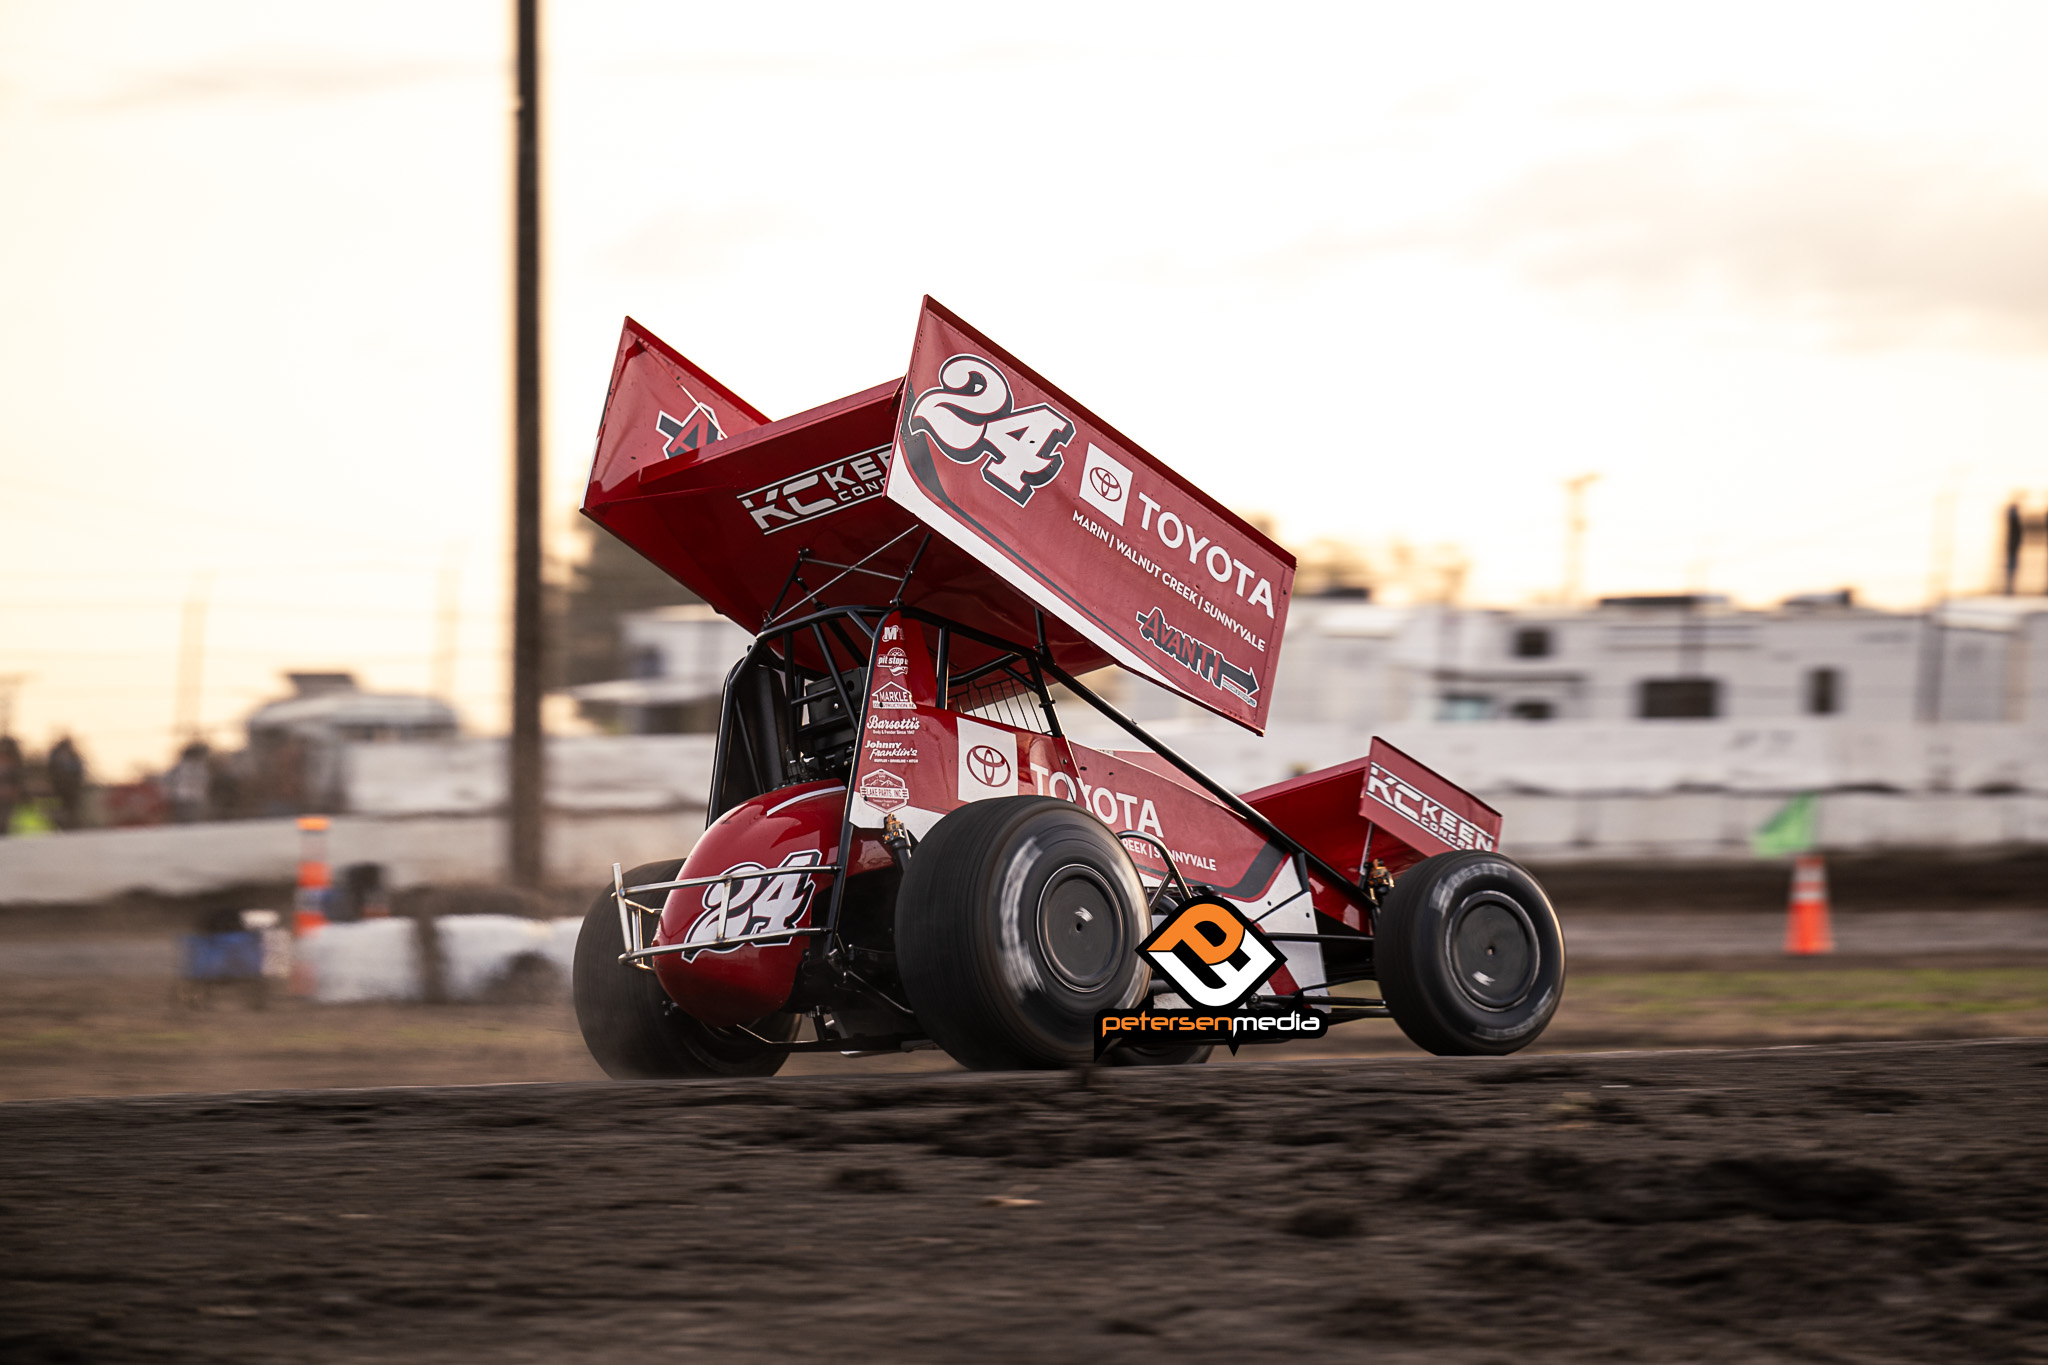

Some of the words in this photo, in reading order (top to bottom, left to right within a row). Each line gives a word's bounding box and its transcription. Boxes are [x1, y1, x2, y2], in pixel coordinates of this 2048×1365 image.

[908, 353, 1076, 508] 24
[1138, 491, 1275, 620] TOYOTA
[1072, 510, 1109, 543] MARIN
[1116, 538, 1162, 578] WALNUT
[1162, 572, 1199, 605] CREEK
[1203, 600, 1266, 652] SUNNYVALE
[878, 656, 888, 665] pit
[889, 656, 904, 666] stop
[1141, 608, 1222, 684] AVANTI
[880, 691, 908, 702] MARKLE
[867, 715, 920, 730] Barsotti's
[865, 740, 902, 748] Johnny
[869, 747, 918, 760] Franklin's
[867, 788, 878, 797] LAKE
[1029, 763, 1164, 838] TOYOTA
[1421, 800, 1494, 852] KEEN
[1122, 838, 1147, 856] REEK
[1154, 844, 1217, 871] SNNYVALE
[681, 849, 822, 964] 24
